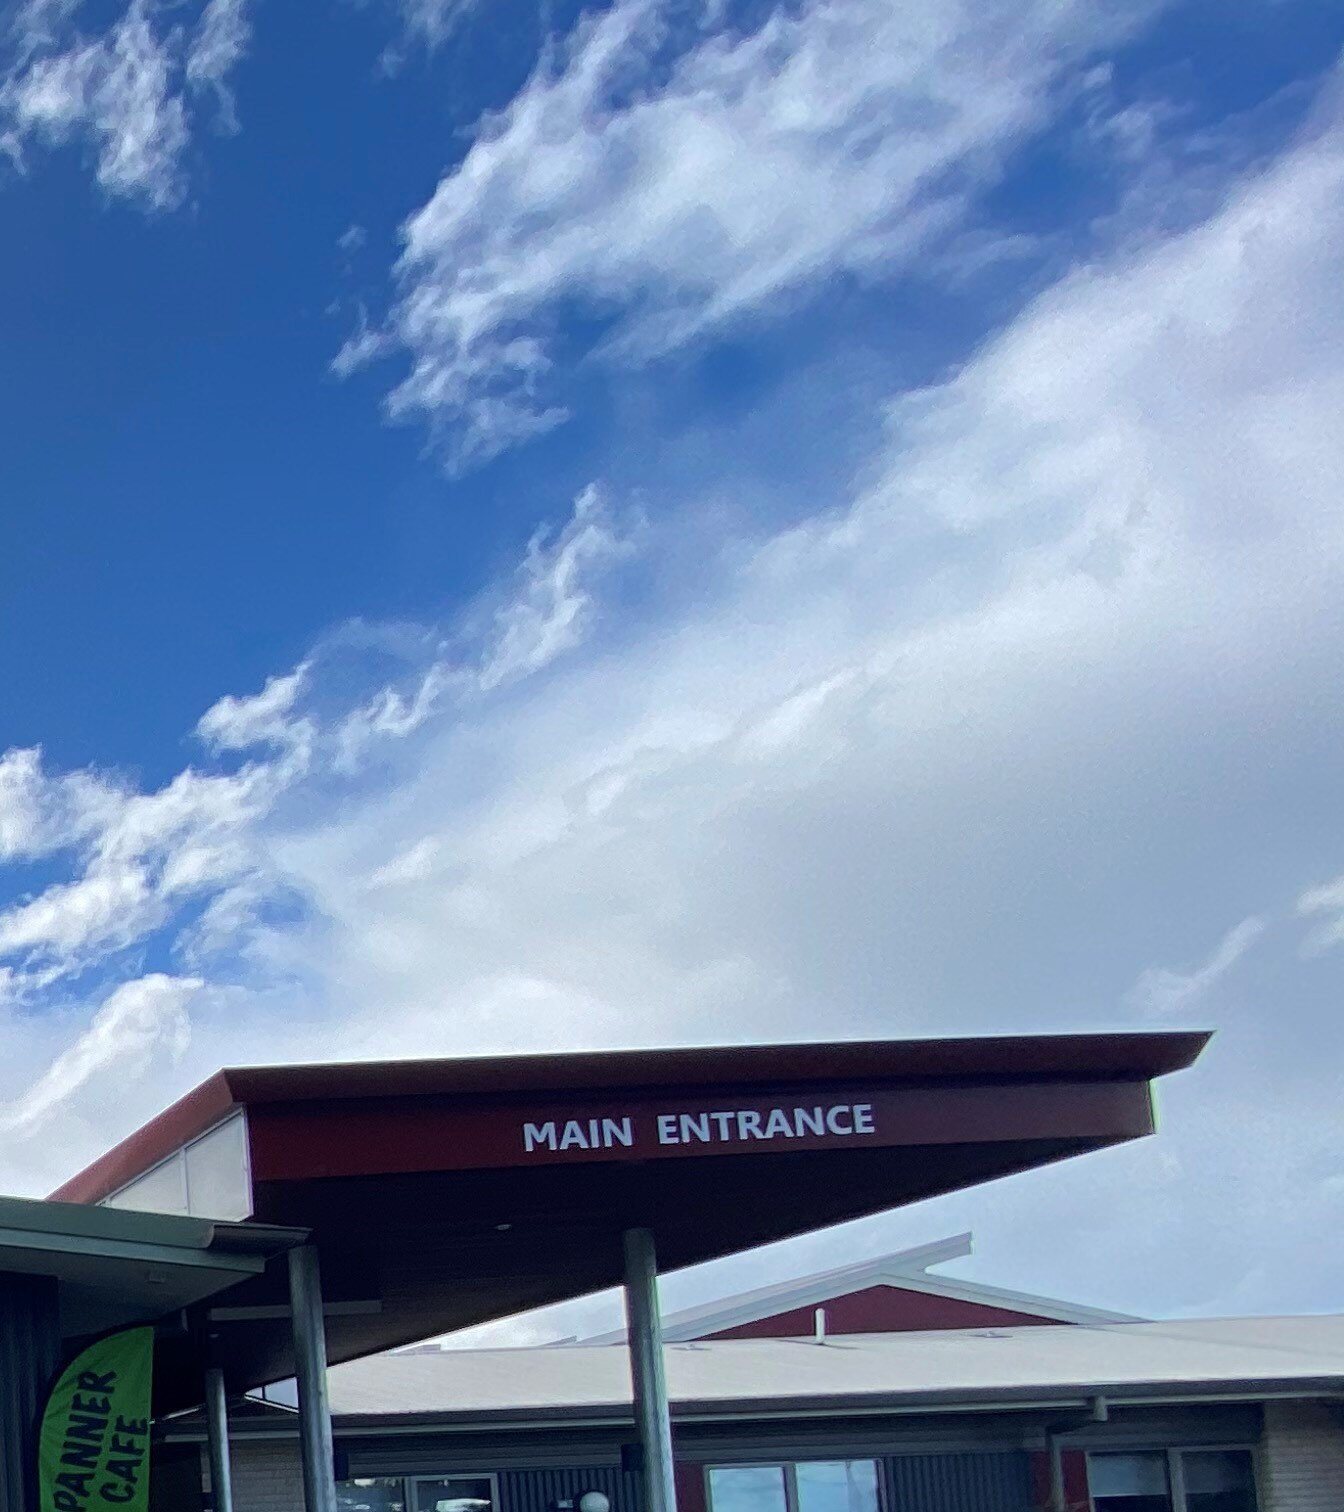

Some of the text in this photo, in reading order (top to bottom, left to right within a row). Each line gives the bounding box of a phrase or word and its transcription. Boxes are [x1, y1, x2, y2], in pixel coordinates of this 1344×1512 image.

[522, 1104, 876, 1152] MAIN ENTRANCE
[99, 1414, 149, 1503] CAFE
